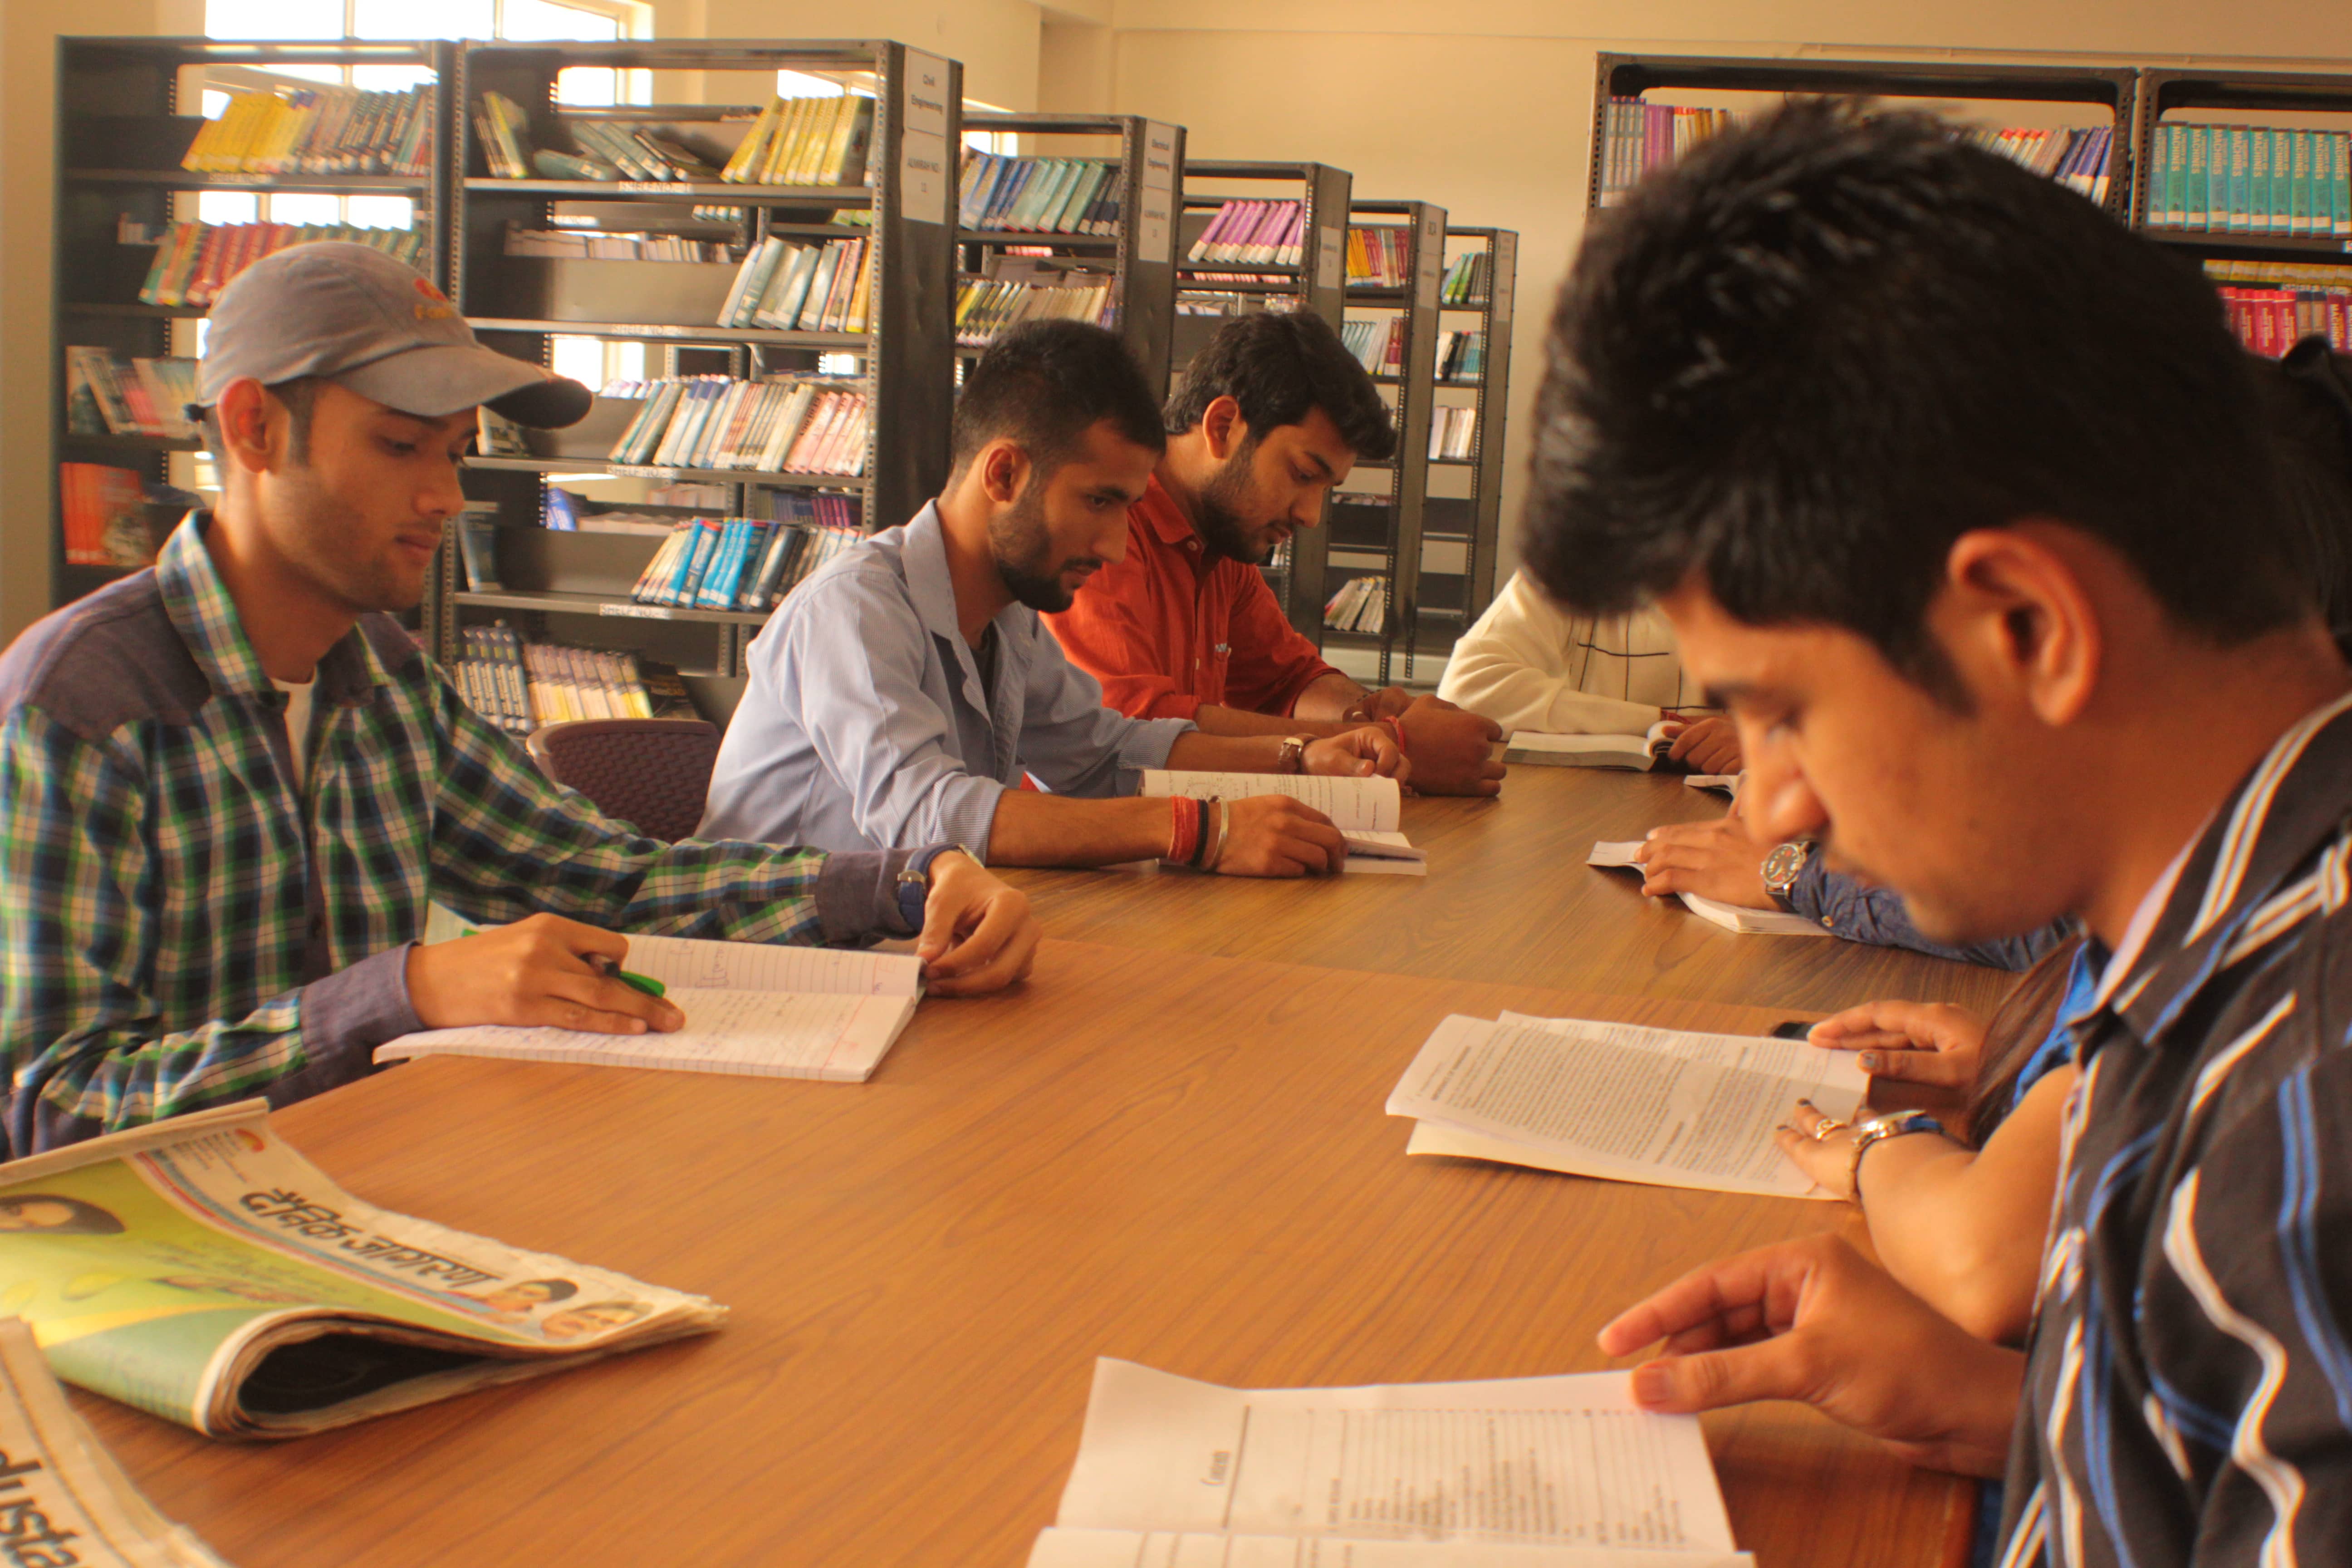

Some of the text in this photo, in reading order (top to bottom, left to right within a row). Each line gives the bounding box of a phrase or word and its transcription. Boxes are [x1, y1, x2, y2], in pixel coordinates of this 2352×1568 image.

[922, 74, 935, 86] Civil
[911, 94, 943, 115] Engineering
[2171, 126, 2181, 171] MACHINES
[2191, 129, 2201, 174] MACHINES
[2213, 129, 2223, 174] MACHINES
[2232, 131, 2243, 176] MACHINES
[2253, 132, 2263, 177] MACHINES
[2274, 132, 2284, 177] MACHINES
[2294, 133, 2304, 178] MACHINES
[2315, 134, 2324, 179] MACHINES
[2335, 135, 2345, 180] MACHINES
[622, 181, 654, 192] SHELF
[612, 324, 645, 335] SHELF
[2330, 304, 2340, 348] MACHINES
[609, 466, 640, 476] SHELF
[601, 604, 632, 616] SHELF
[239, 1187, 365, 1240] दैनिक
[339, 1235, 503, 1289] जागरण
[1199, 1450, 1230, 1486] Contents
